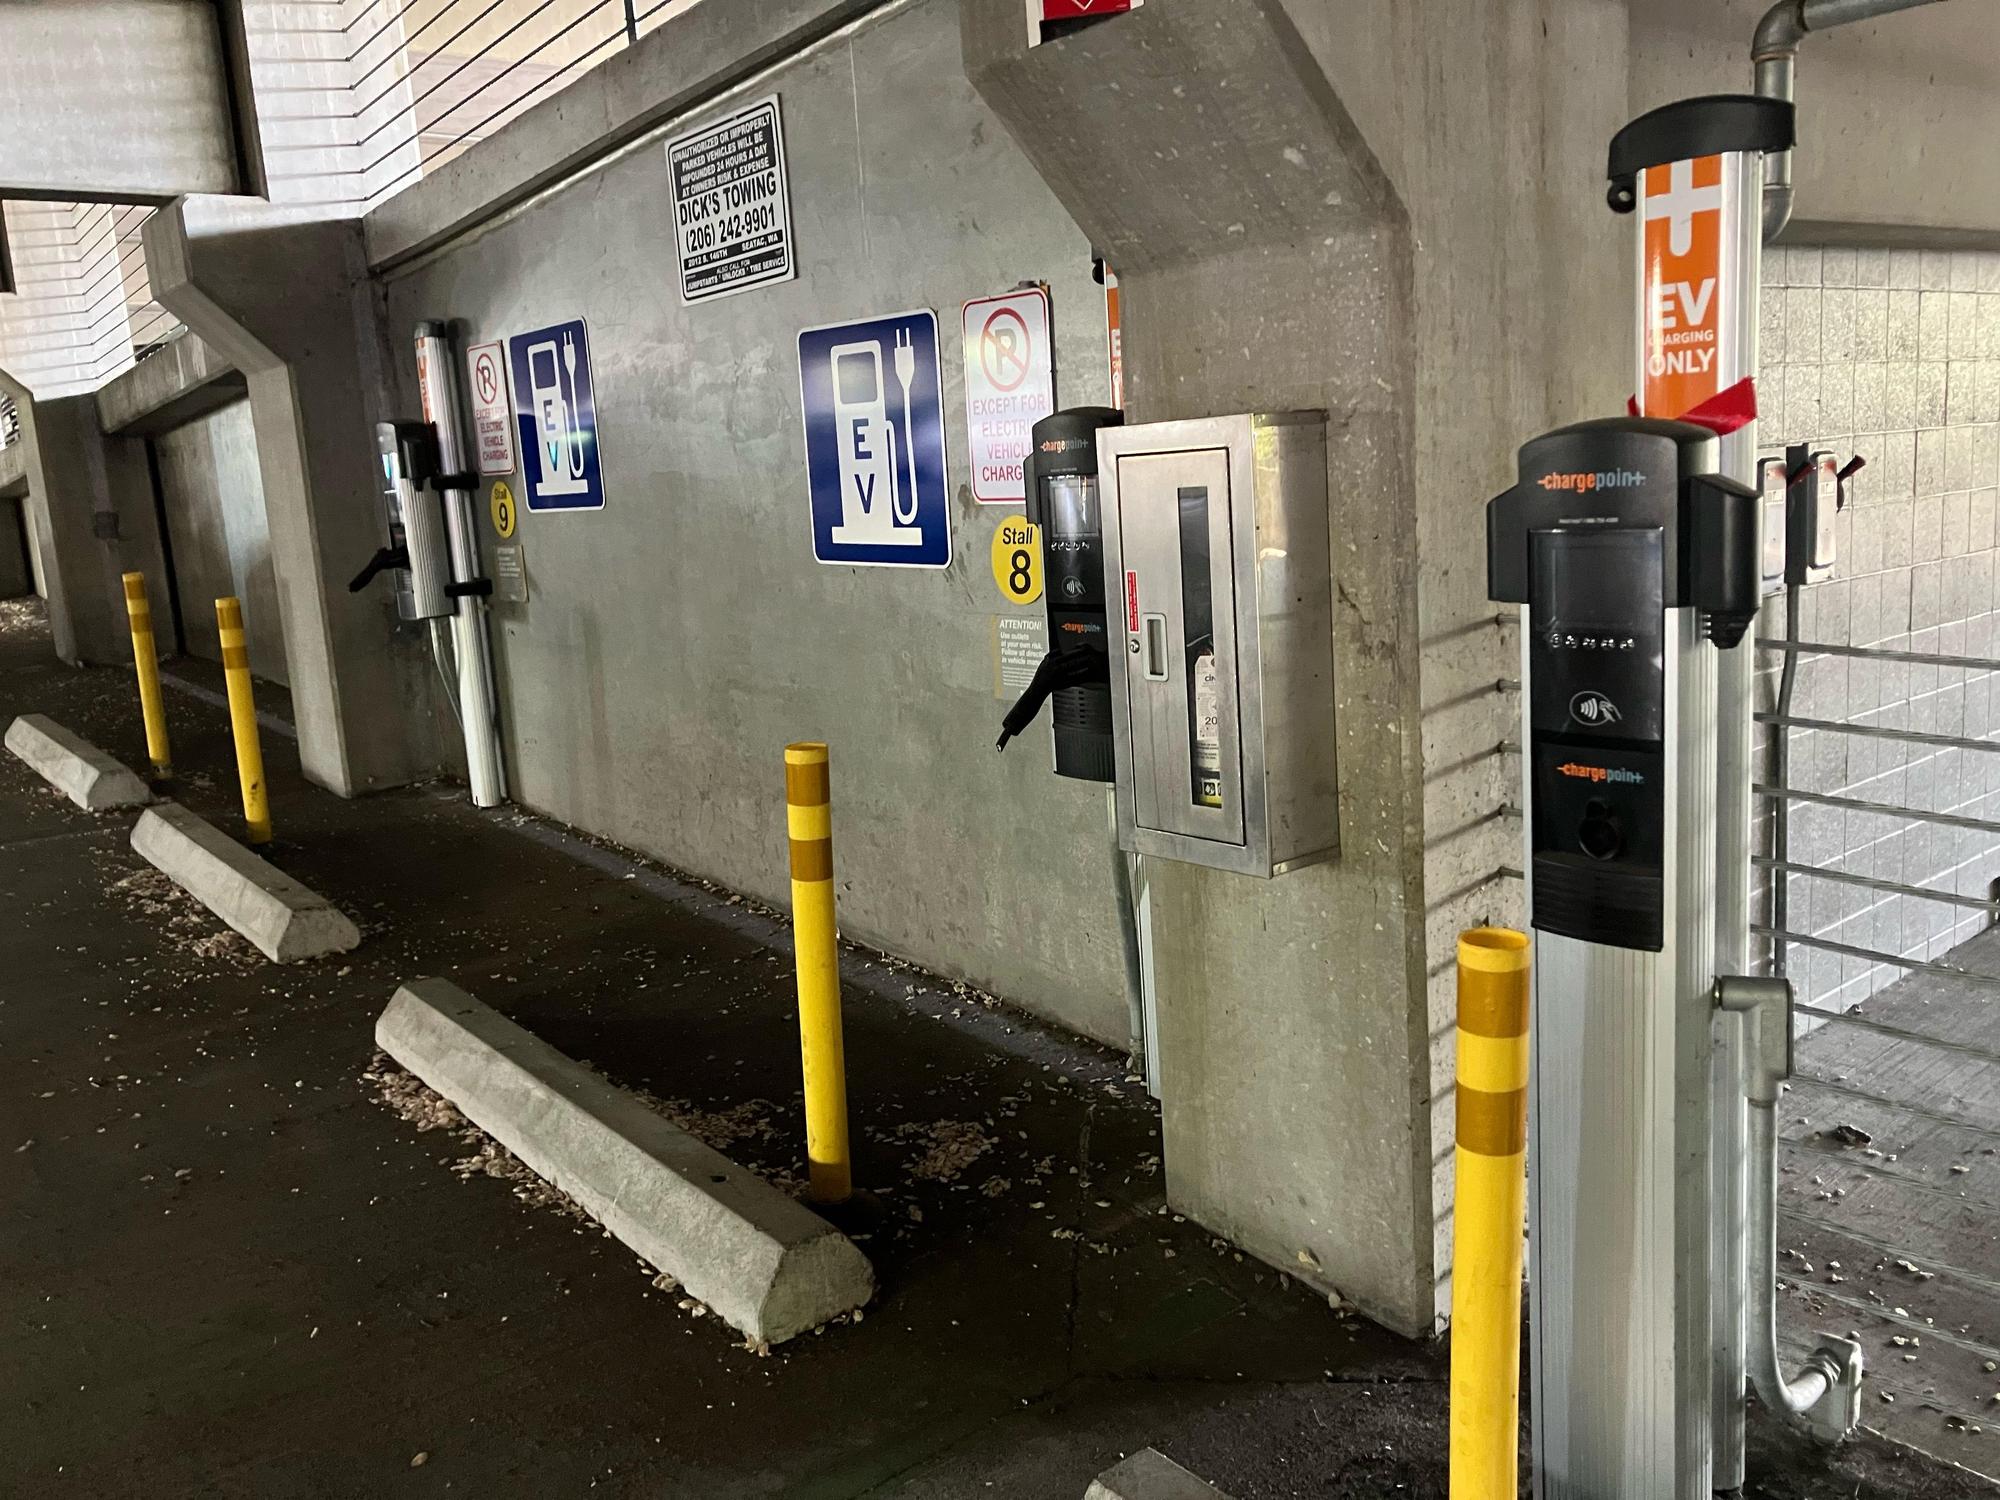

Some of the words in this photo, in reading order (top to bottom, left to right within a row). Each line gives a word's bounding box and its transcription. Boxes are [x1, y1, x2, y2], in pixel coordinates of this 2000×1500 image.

[673, 136, 718, 162] UNAUTHORIZED
[720, 132, 729, 143] OR
[730, 114, 770, 138] IMPROPERLY
[682, 155, 705, 172] PARKED
[706, 142, 736, 162] VEHICLES
[738, 134, 752, 148] WILL
[754, 132, 763, 143] BE
[681, 164, 715, 186] IMPOUNDED
[717, 160, 724, 172] 24
[726, 152, 747, 168] HOURS
[749, 149, 753, 160] A
[754, 143, 767, 157] DAY
[682, 186, 689, 198] AT
[691, 177, 716, 194] OWNERS
[718, 170, 732, 185] RISK
[733, 167, 738, 178] &
[740, 157, 769, 176] EXPENSE
[679, 192, 720, 225] DICK'S
[723, 171, 776, 210] TOWING
[686, 222, 715, 252] (206)
[719, 203, 775, 243] 242-9901
[742, 237, 767, 251] SEATAC,
[767, 233, 778, 243] WA
[729, 262, 740, 271] CALL
[763, 256, 784, 270] SERVICE
[1651, 278, 1716, 329] EV
[1648, 347, 1715, 376] ONLY
[973, 396, 1018, 416] EXCEPT
[1020, 394, 1046, 412] FOR
[480, 420, 503, 433] ELECTRIC
[484, 435, 504, 447] VEHICLE
[482, 449, 508, 461] CHARGING
[982, 465, 1024, 482] CHARG
[495, 488, 507, 500] Stall
[500, 502, 508, 532] 9
[1003, 526, 1033, 545] Stall
[1009, 549, 1032, 595] 8
[1000, 619, 1042, 630] ATTENTION!
